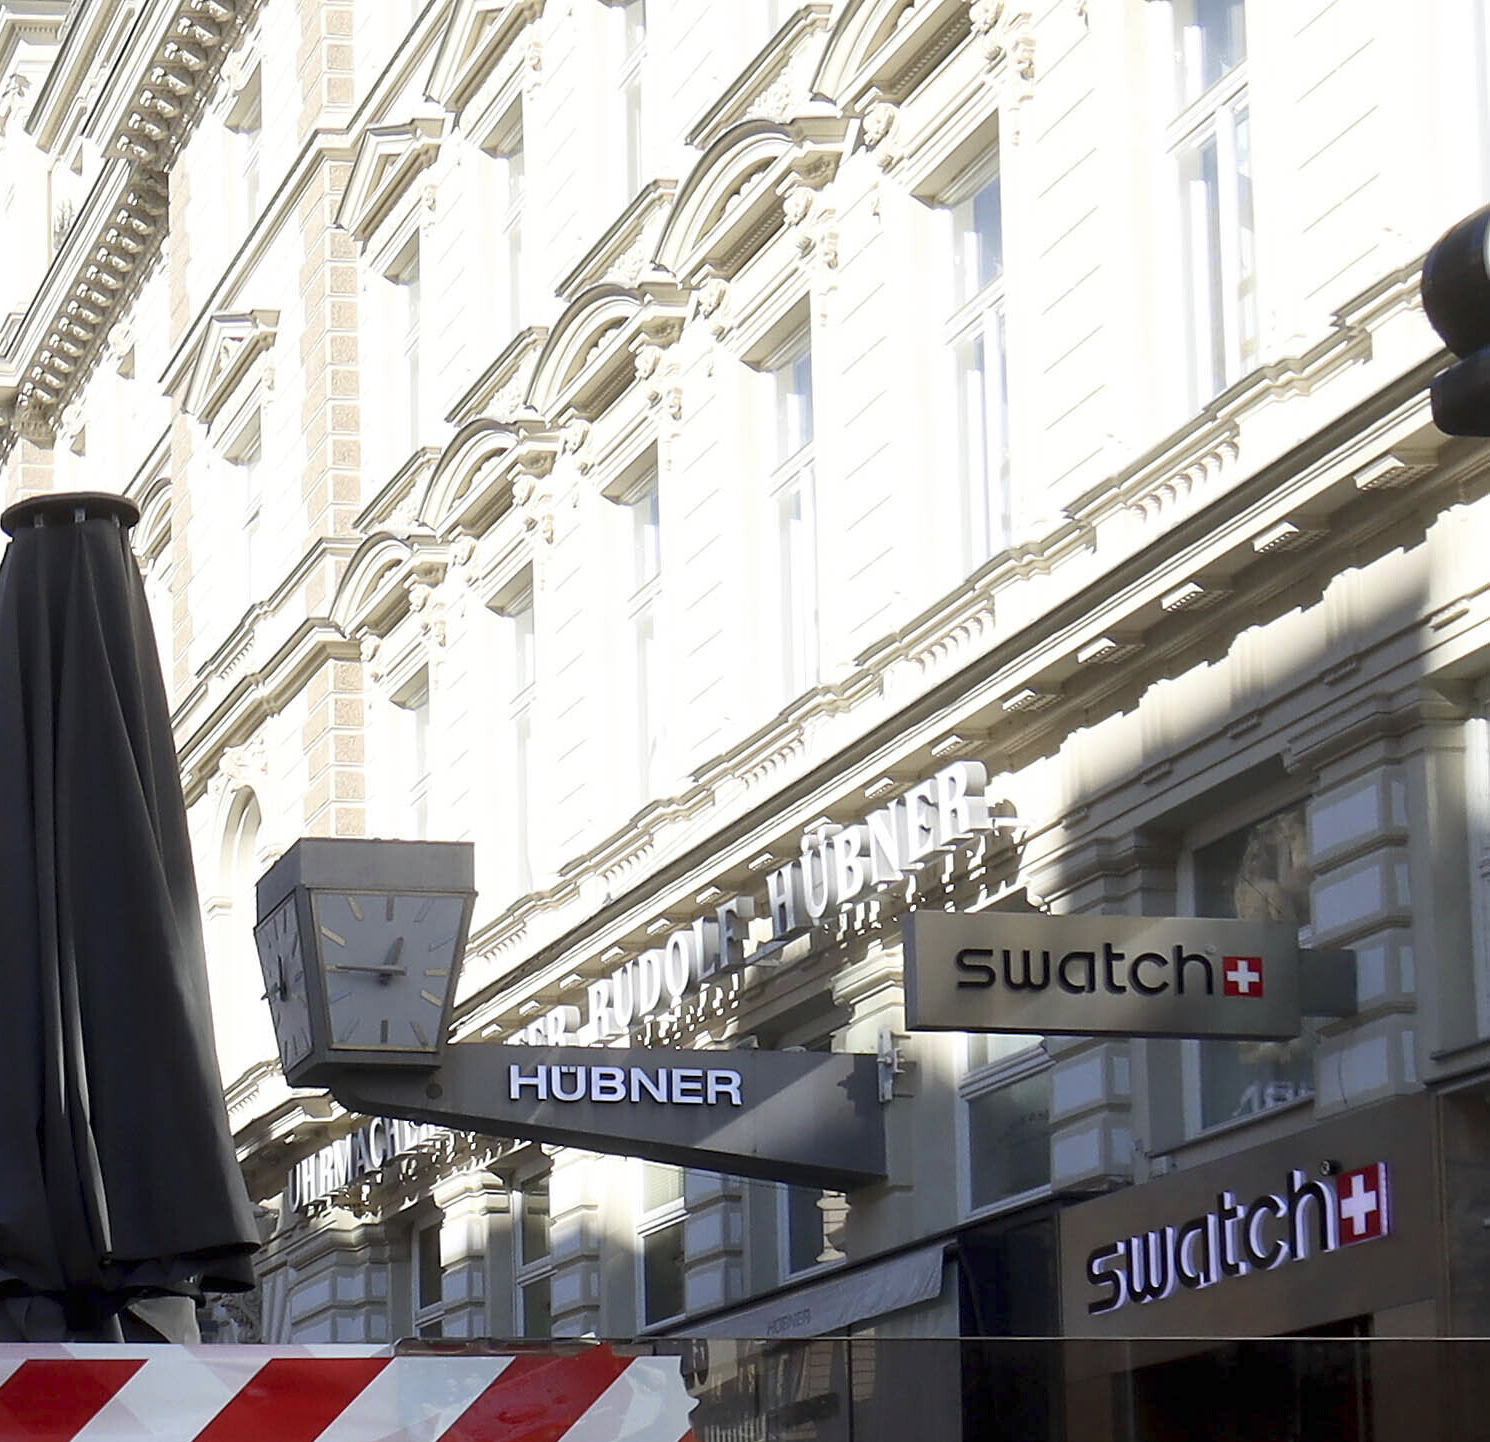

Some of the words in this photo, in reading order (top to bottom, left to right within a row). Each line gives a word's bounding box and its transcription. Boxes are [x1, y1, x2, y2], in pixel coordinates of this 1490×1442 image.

[587, 894, 754, 1040] RUDOLF
[764, 760, 989, 938] HÜBNER
[955, 942, 1215, 996] swatch
[509, 1064, 742, 1106] HÜBNER
[1086, 1168, 1338, 1316] swatch
